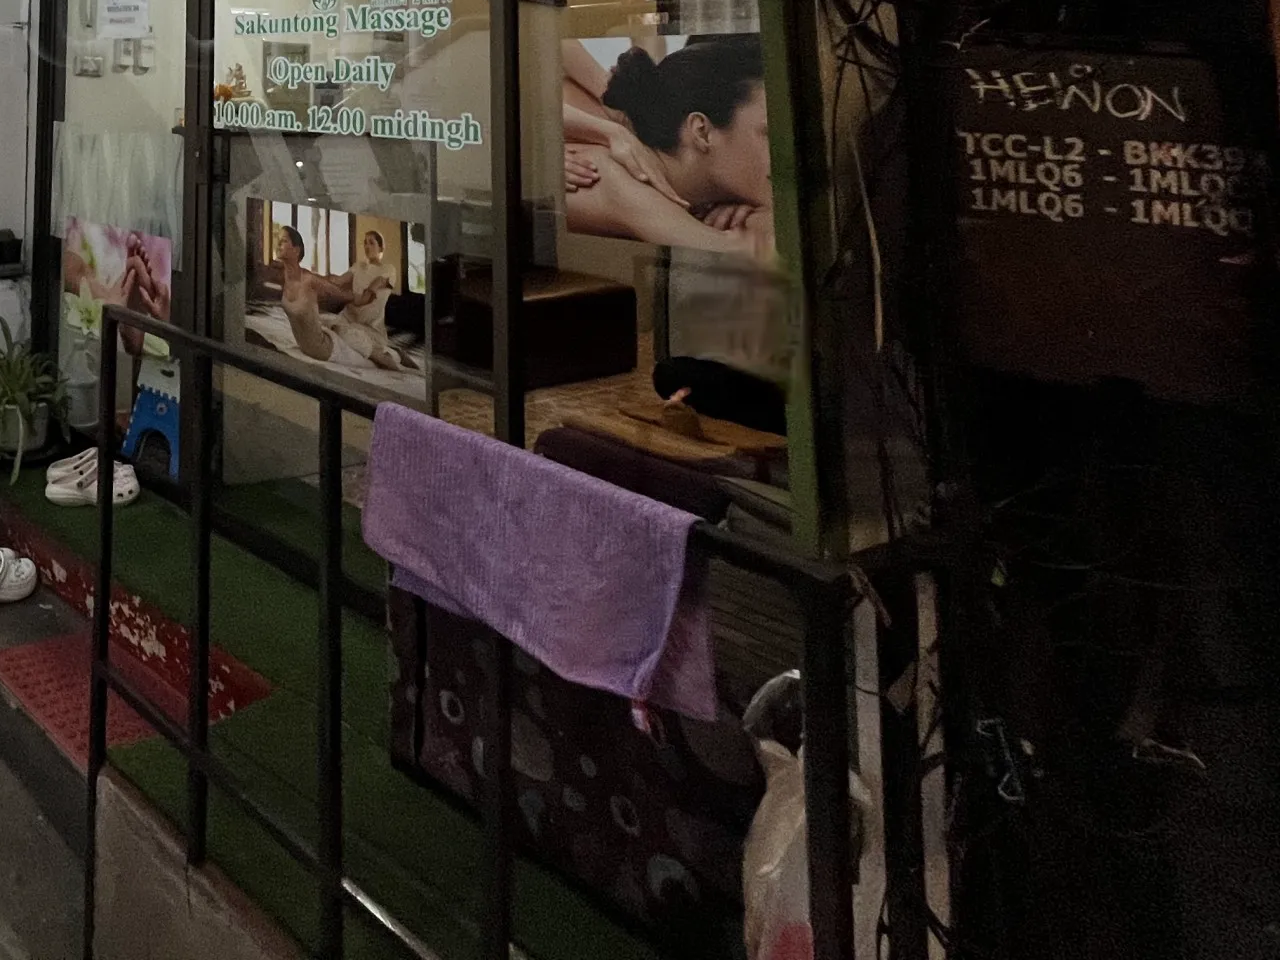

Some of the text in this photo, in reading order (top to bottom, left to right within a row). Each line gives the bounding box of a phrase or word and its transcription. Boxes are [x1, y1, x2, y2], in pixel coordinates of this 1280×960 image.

[234, 5, 451, 38] Sakuntong Massage
[271, 56, 396, 90] Open Daily
[265, 108, 301, 131] am.
[308, 106, 366, 134] 12.00
[371, 111, 482, 150] midingh
[970, 158, 1084, 191] 1MLQ6
[971, 187, 1085, 223] 1MLQ6
